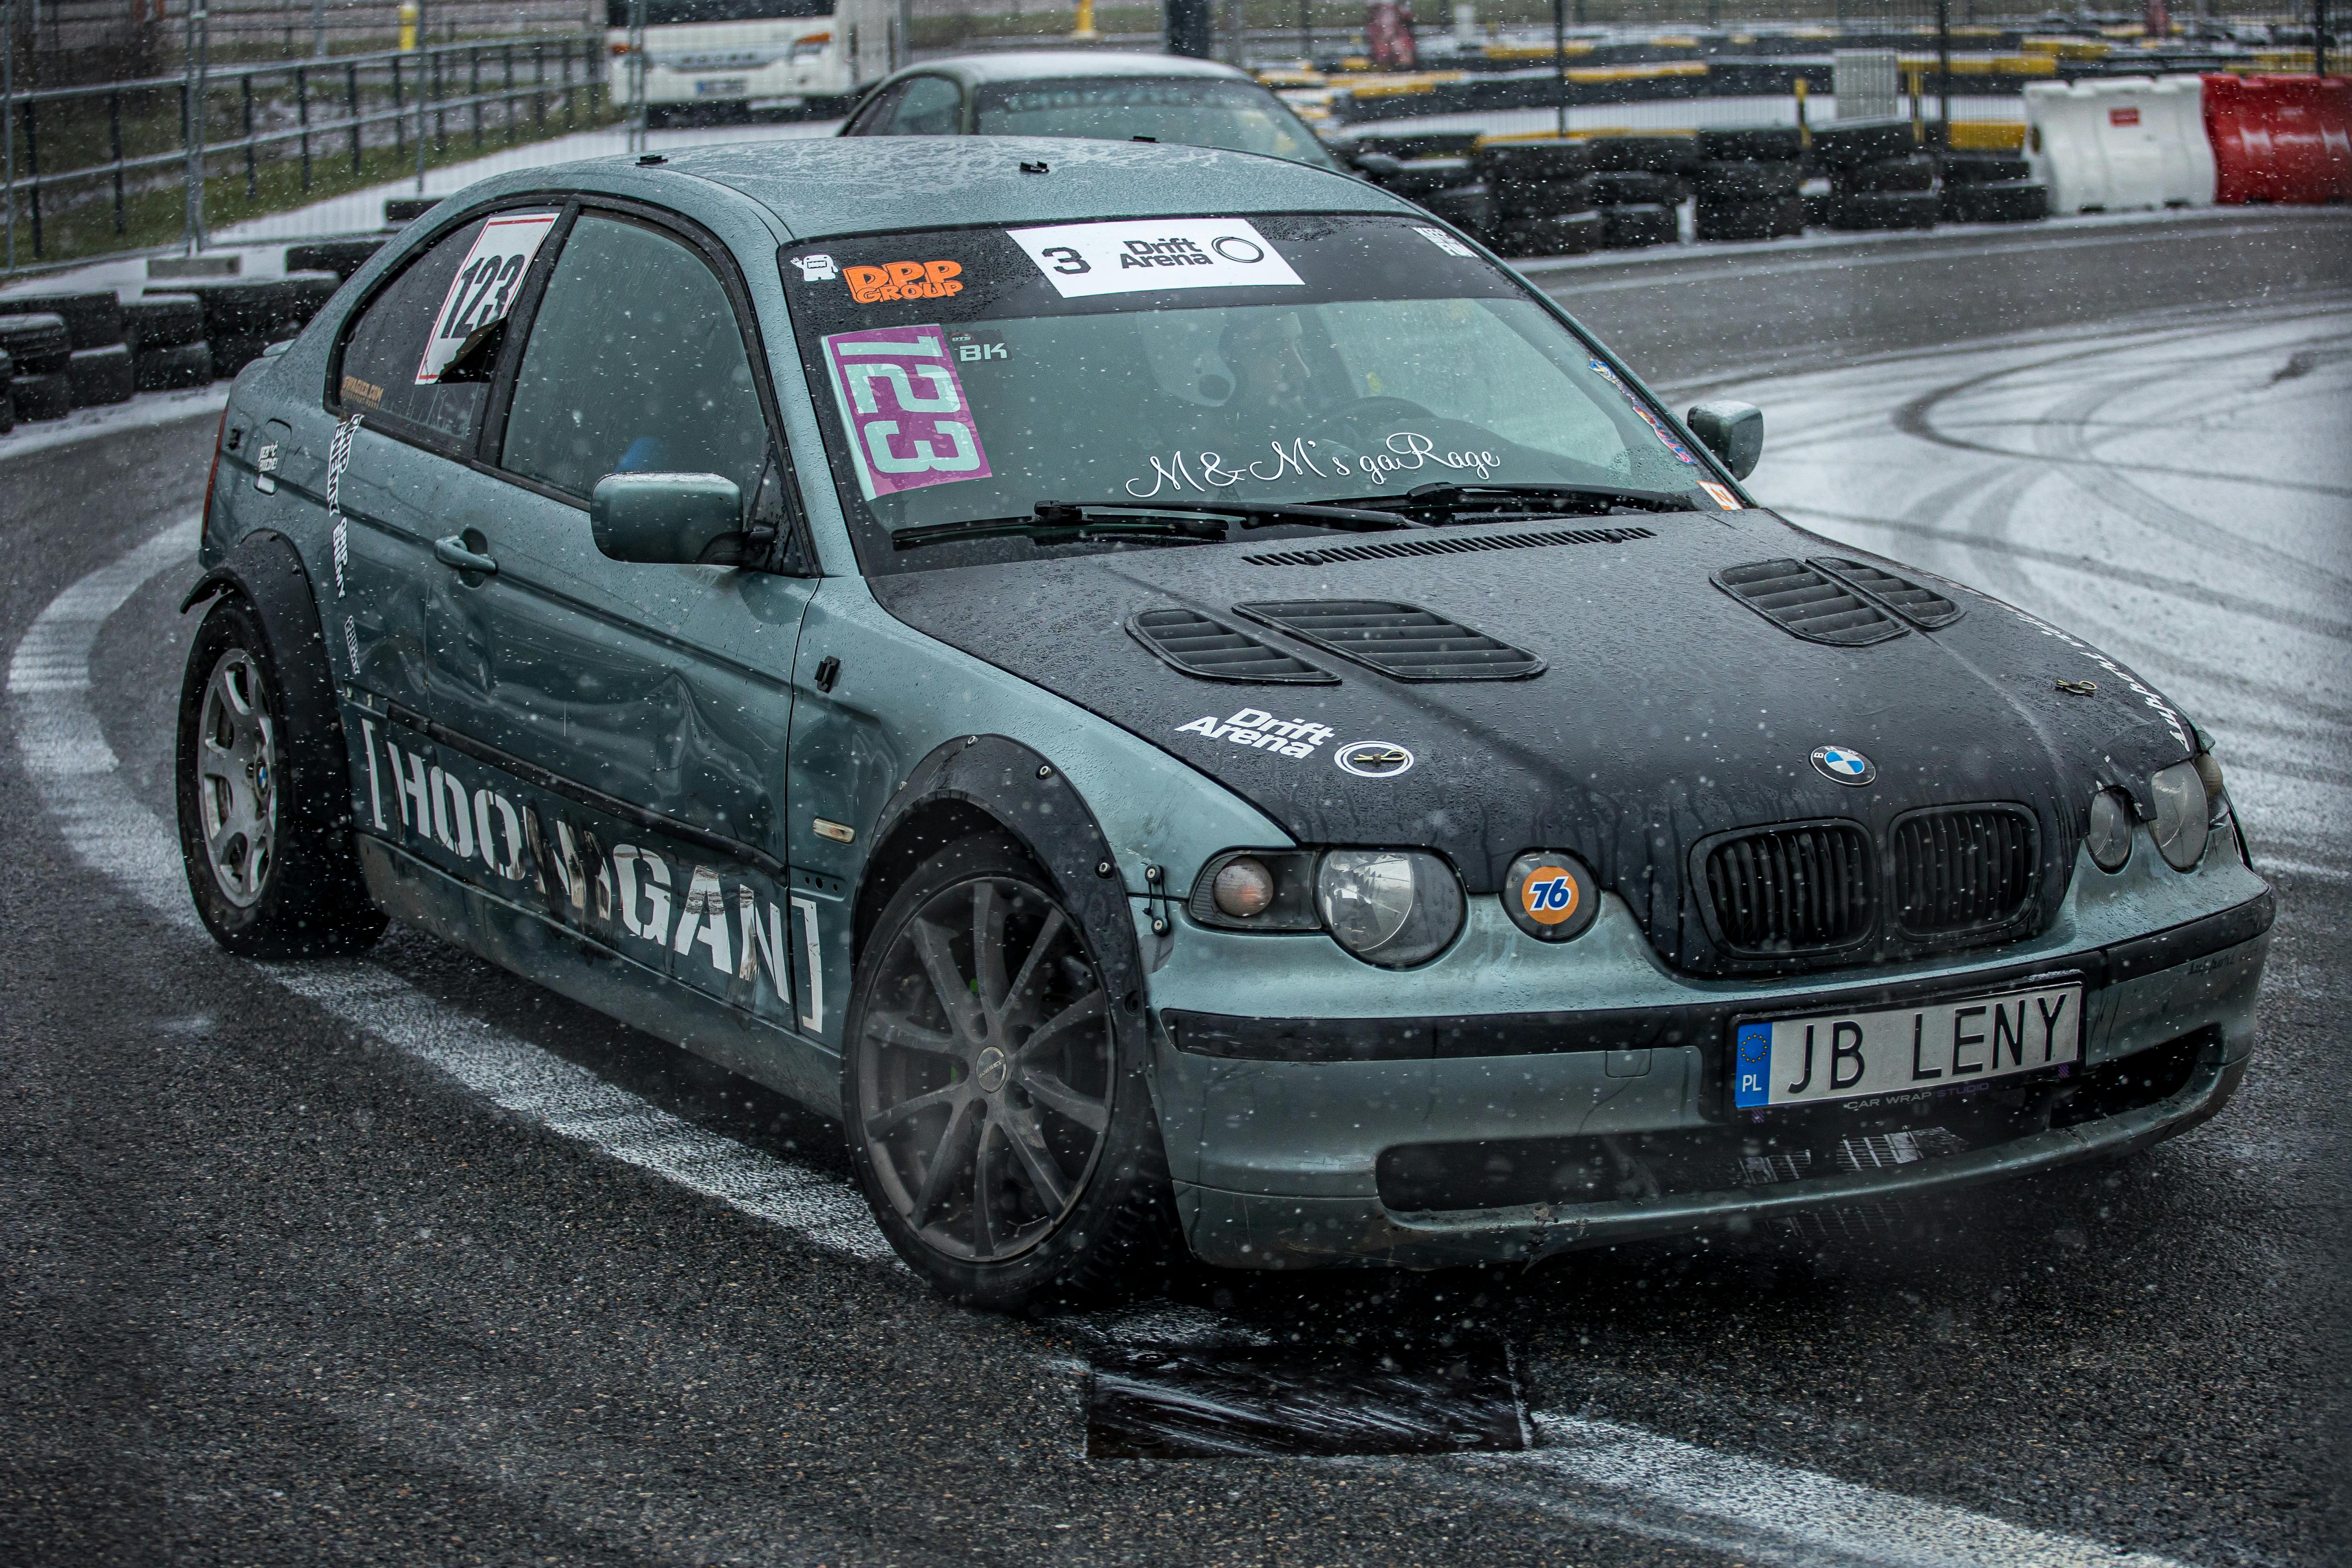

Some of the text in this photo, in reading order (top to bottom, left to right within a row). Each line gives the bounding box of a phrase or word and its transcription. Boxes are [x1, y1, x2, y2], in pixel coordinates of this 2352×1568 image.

[1041, 247, 1092, 275] 3
[1119, 251, 1214, 269] Arena
[1122, 238, 1202, 255] Drift
[843, 260, 962, 290] DPP
[440, 254, 525, 339] 123
[855, 281, 964, 304] GROUP
[959, 343, 1007, 361] BK
[837, 335, 980, 473] 123
[1125, 450, 1206, 497] M
[1200, 452, 1247, 487] &
[1359, 432, 1501, 485] gaRage
[333, 524, 346, 598] ENEMY
[1174, 716, 1317, 759] Arena
[1224, 707, 1335, 746] Drift
[1813, 746, 1859, 758] BMW
[1528, 876, 1572, 911] 76
[1787, 993, 2068, 1093] JB LENY
[1742, 1074, 1762, 1092] PL
[1846, 1082, 1990, 1109] CAR WRAP STUDIO
